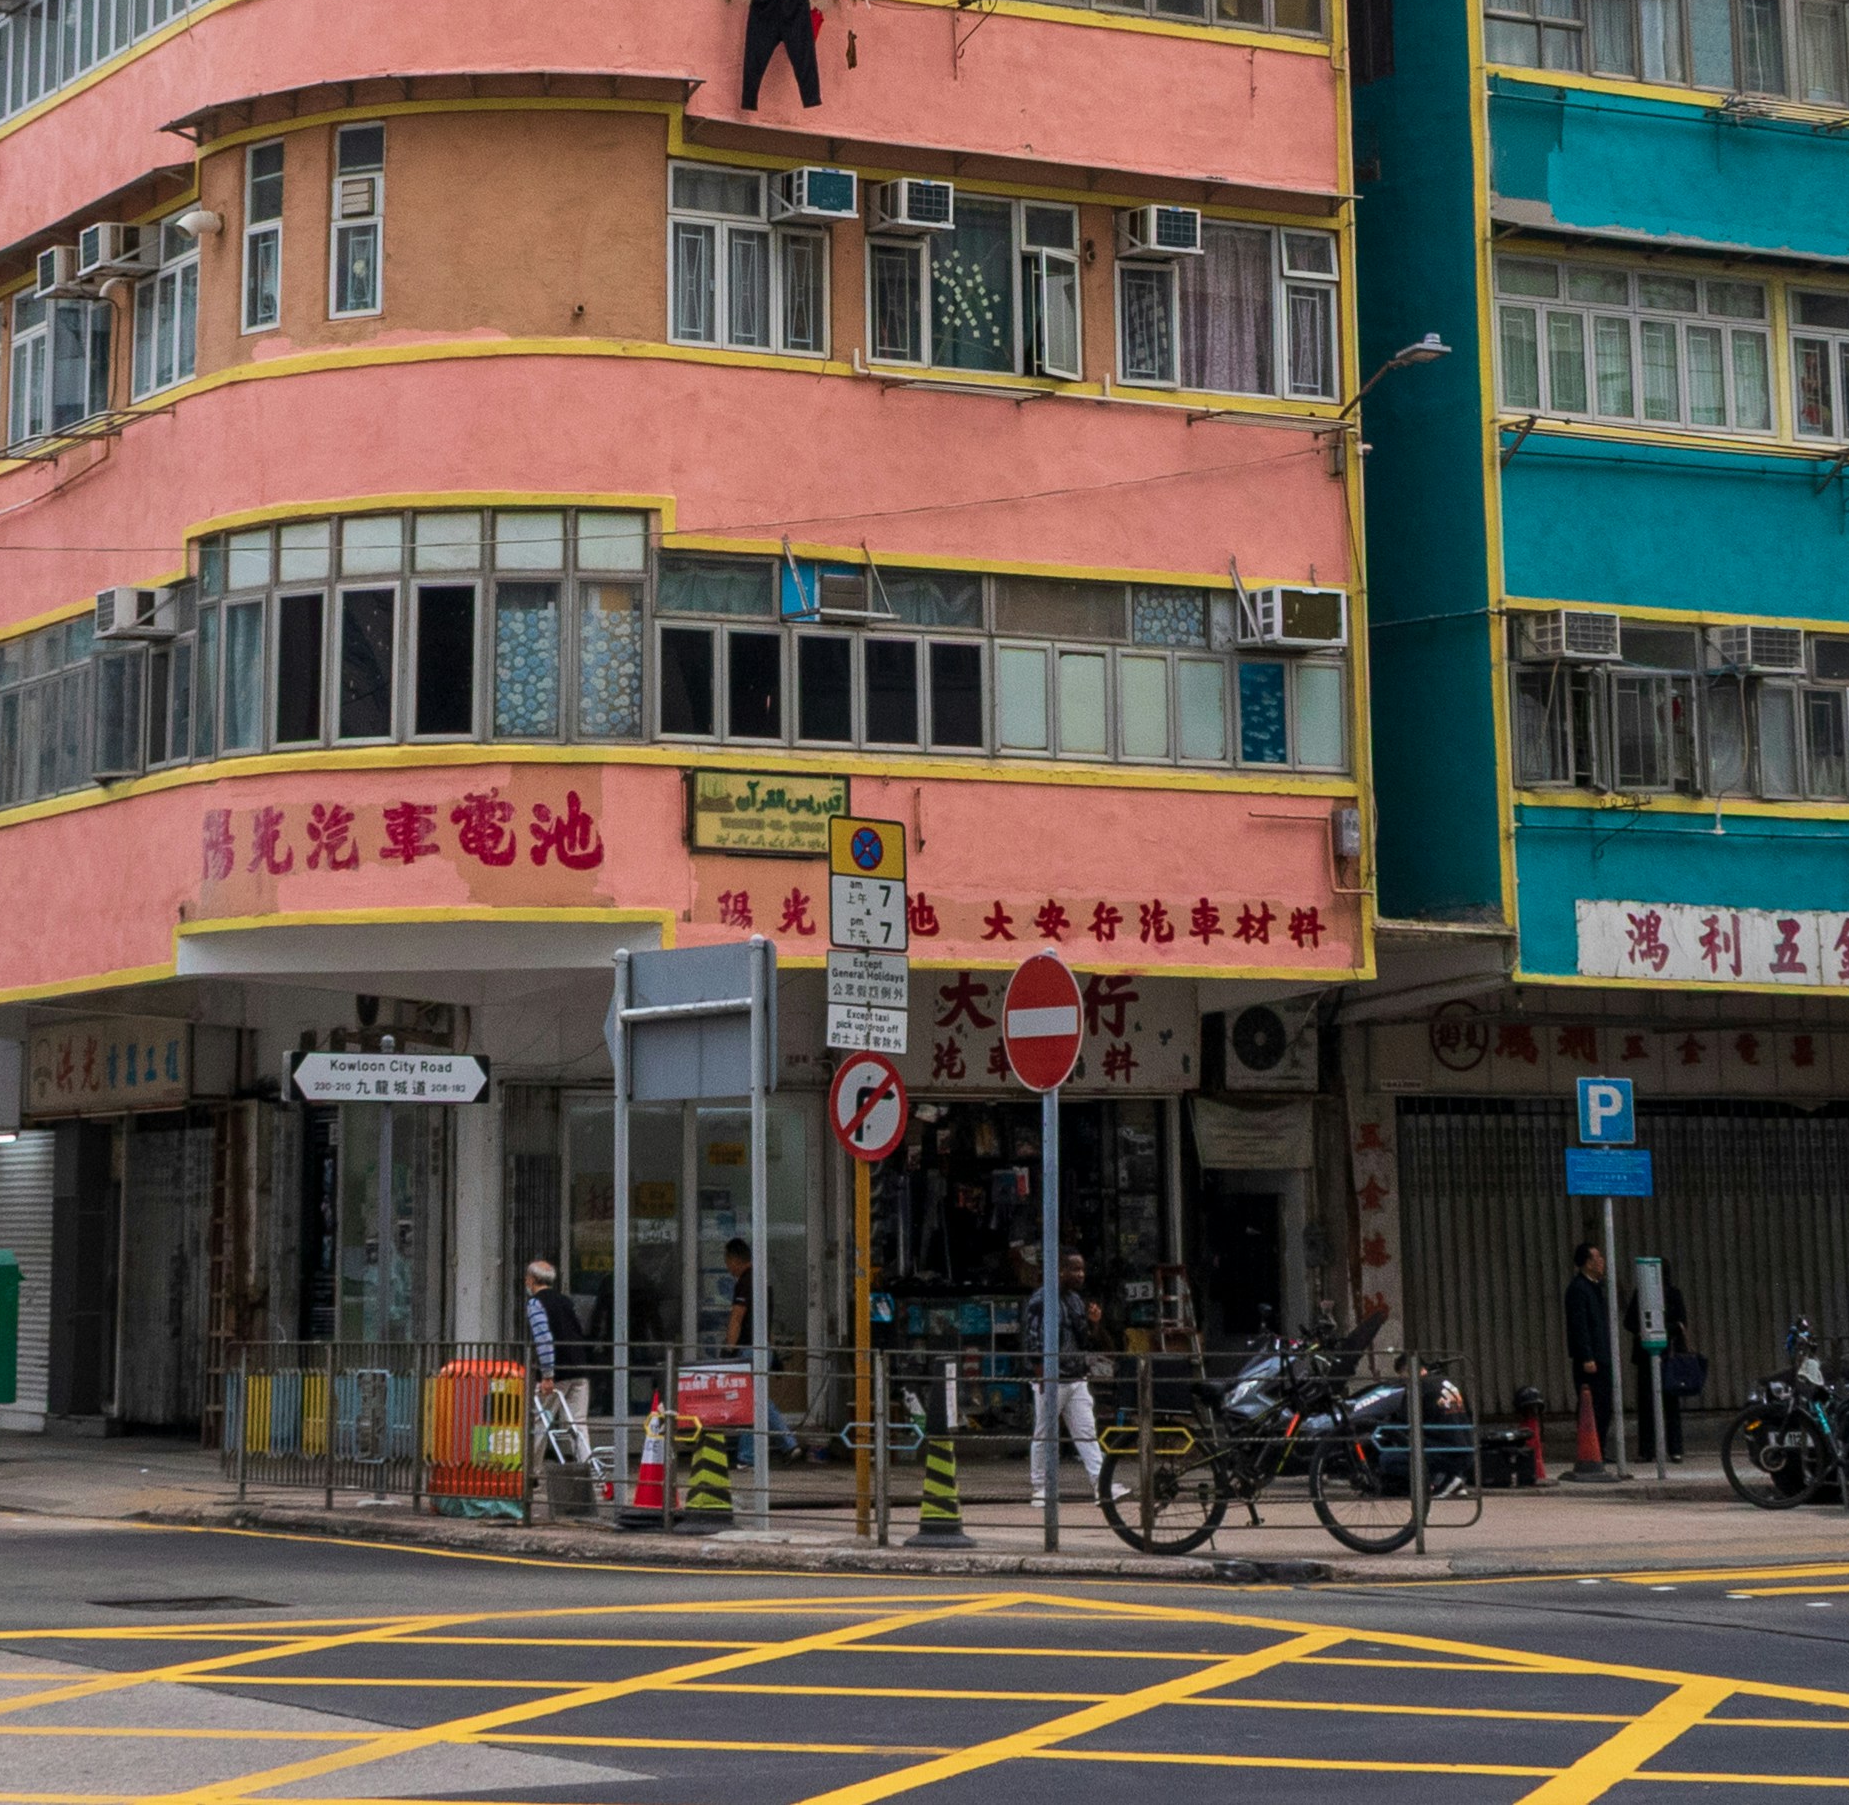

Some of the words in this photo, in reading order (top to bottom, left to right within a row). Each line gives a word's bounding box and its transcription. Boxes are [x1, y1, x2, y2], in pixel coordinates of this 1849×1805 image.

[202, 789, 605, 881] 陽光汽車電池
[846, 893, 867, 905] 上午
[850, 880, 863, 889] am
[878, 884, 892, 908] 7
[717, 887, 940, 938] 陽光池
[979, 897, 1326, 948] 大安行汽車材料
[846, 928, 867, 942] 下午
[850, 916, 864, 928] pm
[879, 921, 893, 944] 7
[852, 957, 883, 971] Except
[831, 967, 865, 980] General
[866, 970, 905, 984] Holidays
[845, 1008, 873, 1022] Except
[874, 1012, 890, 1023] taxi
[936, 971, 1139, 1038] 大行
[835, 1020, 852, 1031] pick
[886, 1025, 899, 1034] off
[329, 1059, 386, 1073] Kowloon
[389, 1060, 416, 1074] City
[420, 1061, 453, 1073] Road
[932, 1041, 1140, 1084] 汽車料
[356, 1079, 427, 1096] 九龍城道
[1587, 1085, 1624, 1136] P
